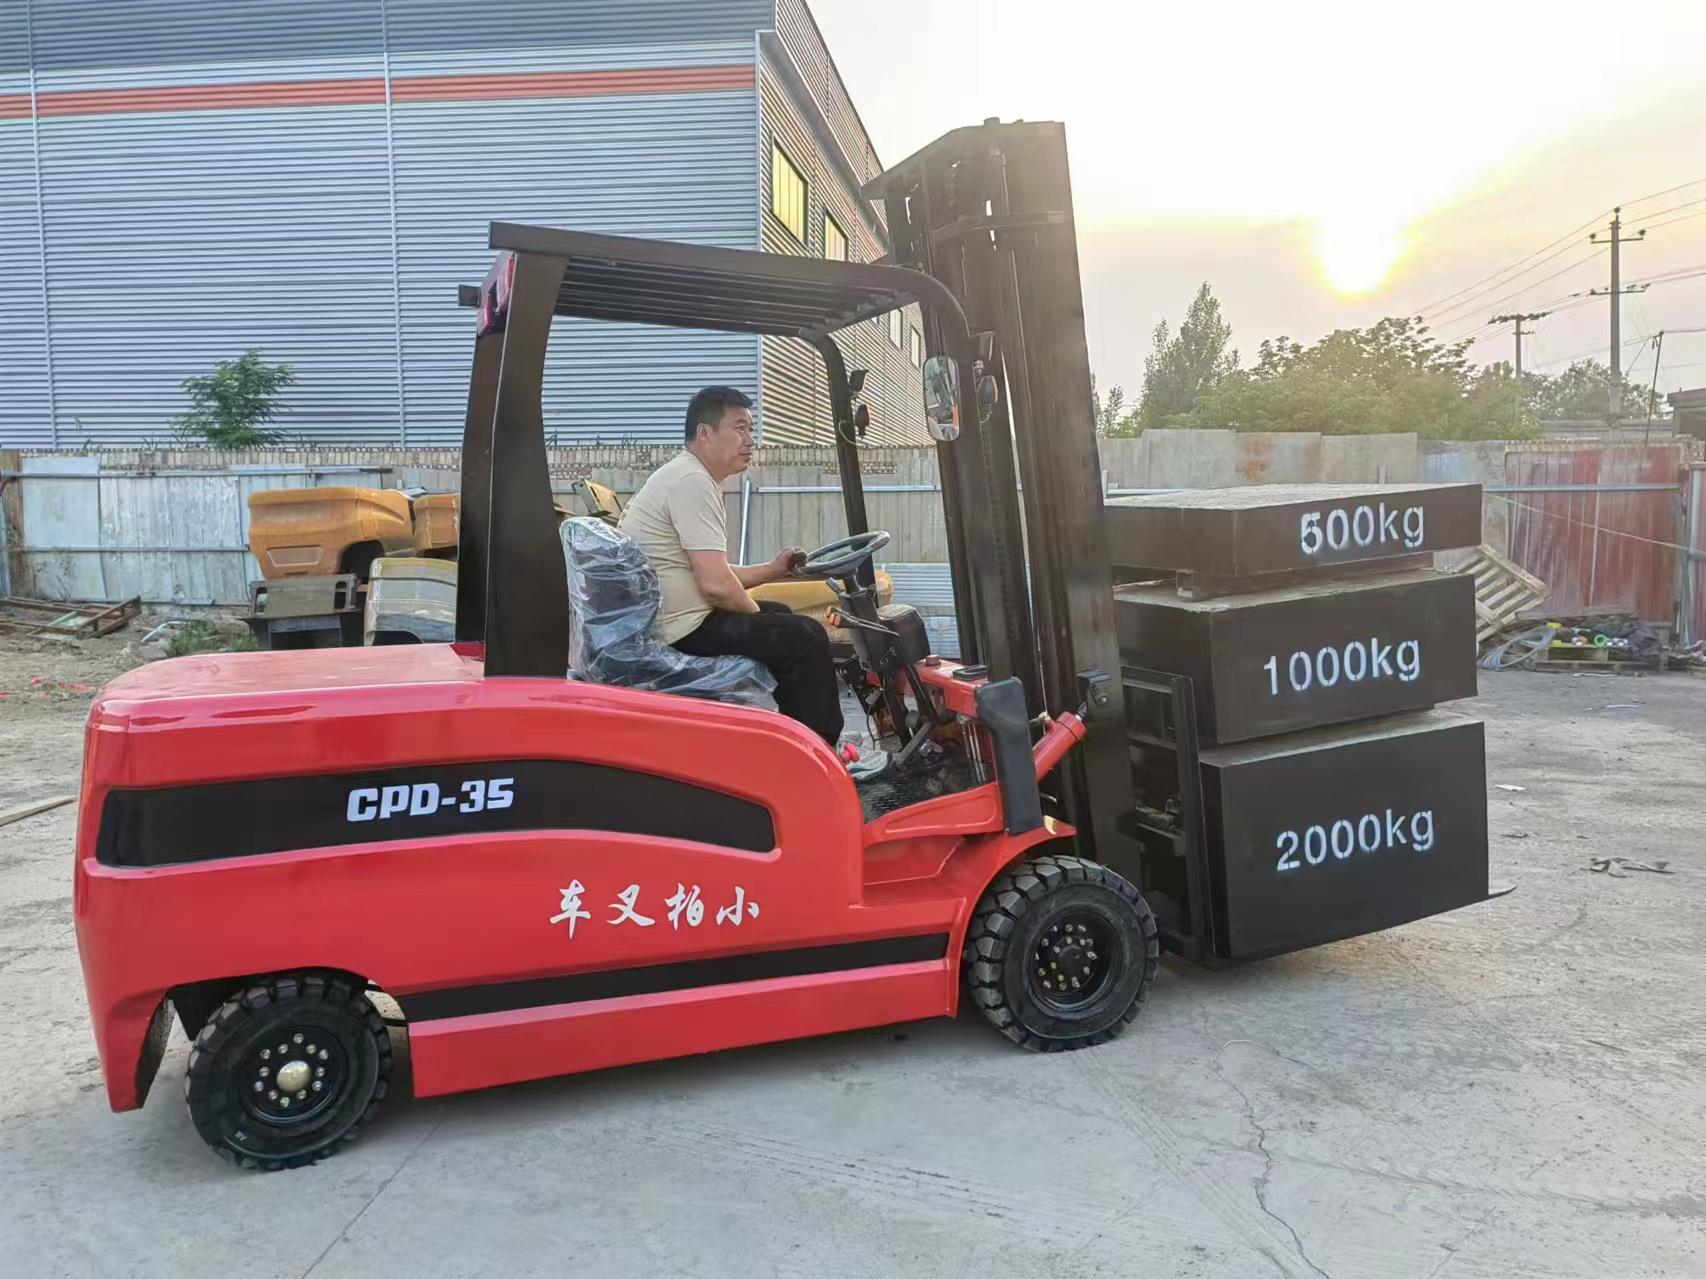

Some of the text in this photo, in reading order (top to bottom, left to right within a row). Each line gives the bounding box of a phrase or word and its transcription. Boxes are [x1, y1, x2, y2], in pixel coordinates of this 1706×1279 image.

[1300, 502, 1425, 555] 500kg
[1264, 637, 1420, 696] 1000kg
[346, 777, 514, 822] CPD-35
[1276, 808, 1435, 872] 2000kg
